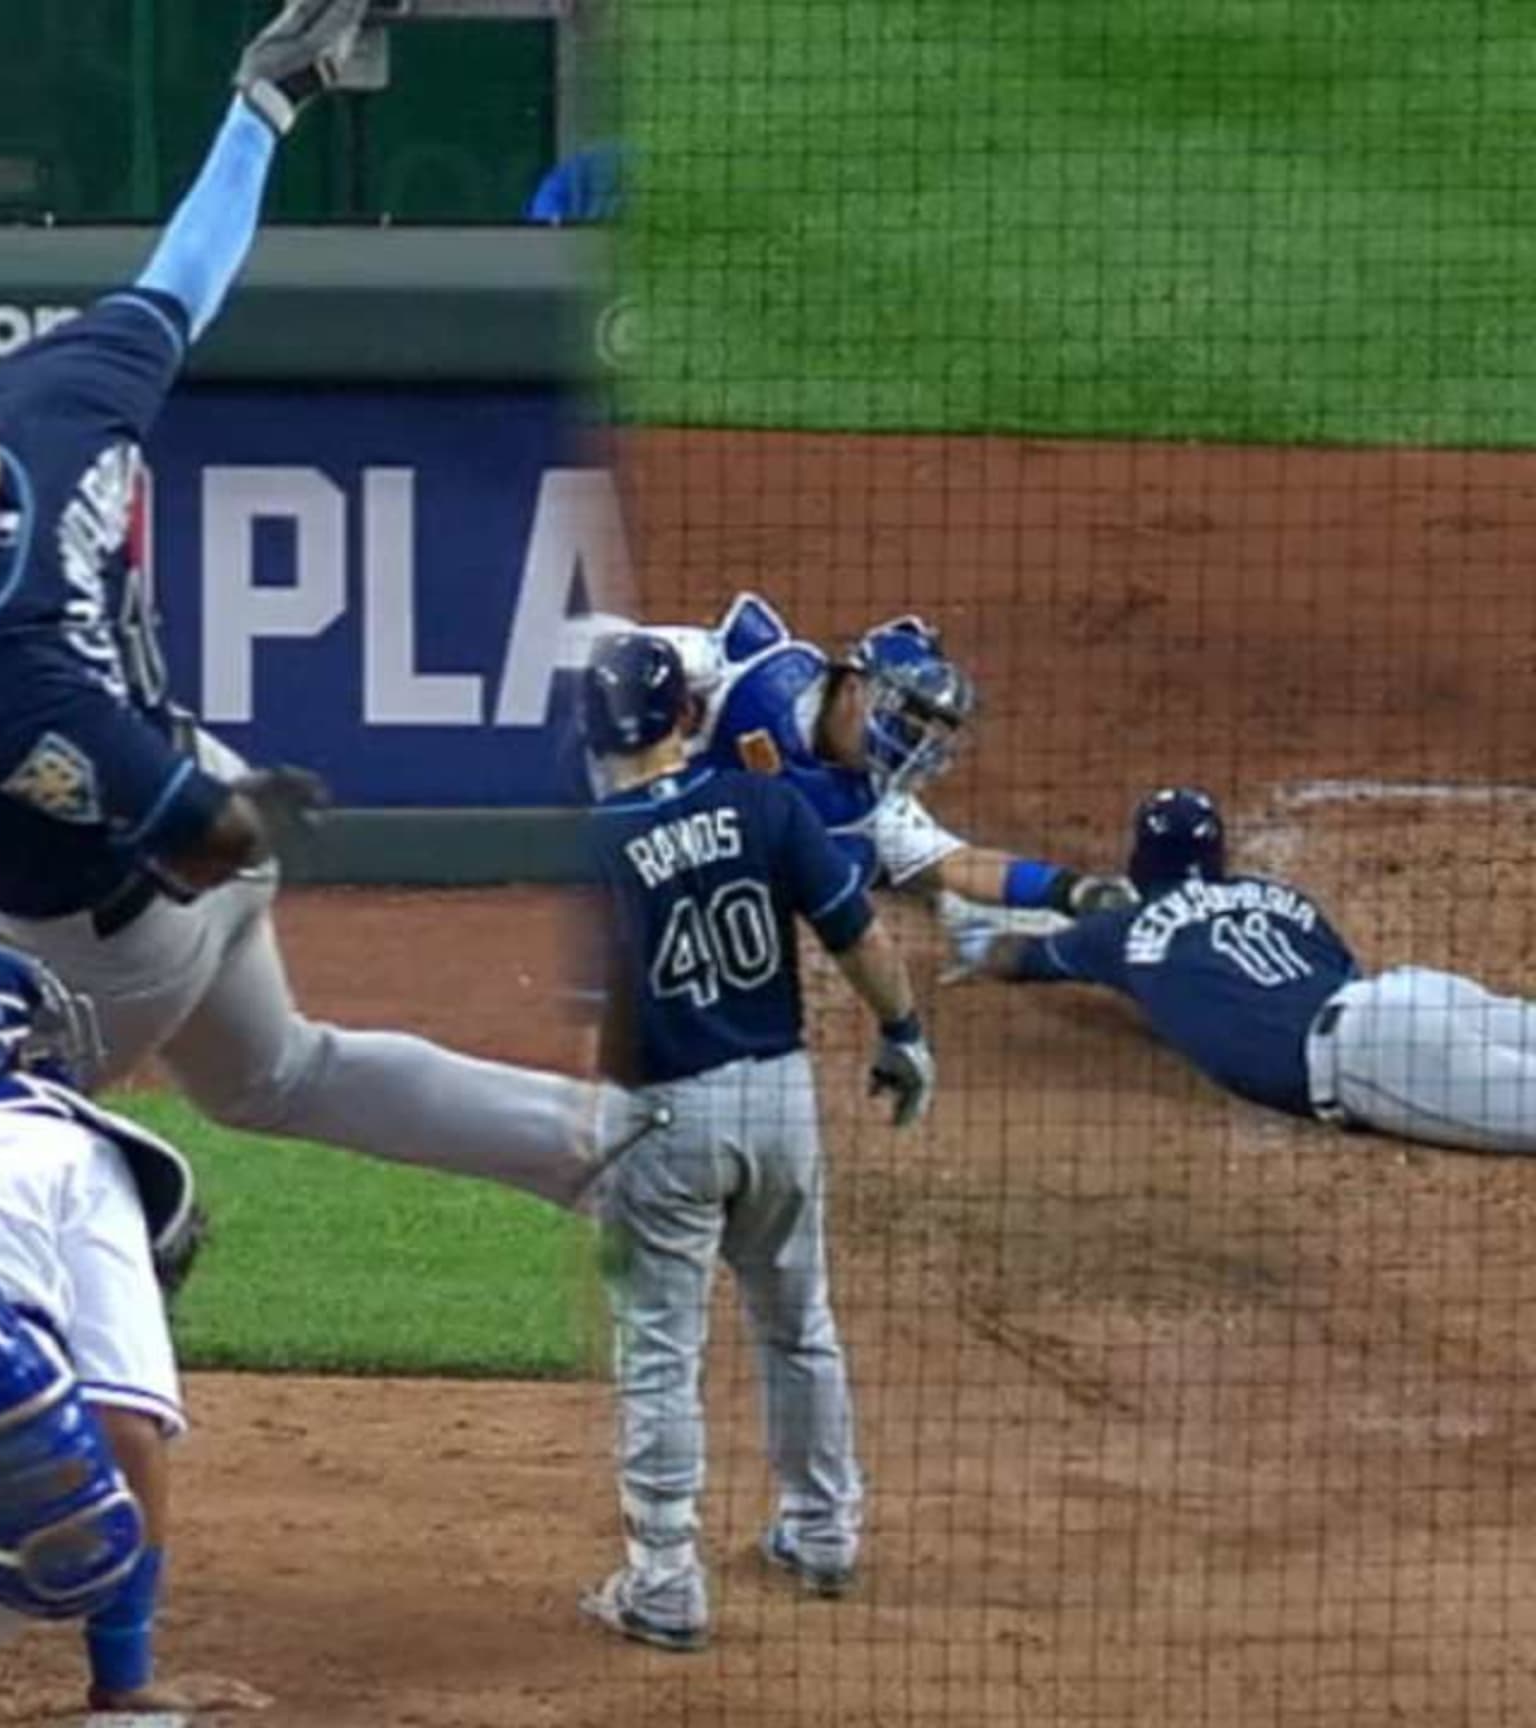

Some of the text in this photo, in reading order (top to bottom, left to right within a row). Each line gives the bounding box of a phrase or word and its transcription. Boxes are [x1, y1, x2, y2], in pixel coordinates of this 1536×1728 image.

[201, 466, 646, 727] PLA
[623, 807, 743, 890] RAMOS
[650, 877, 781, 1008] 40
